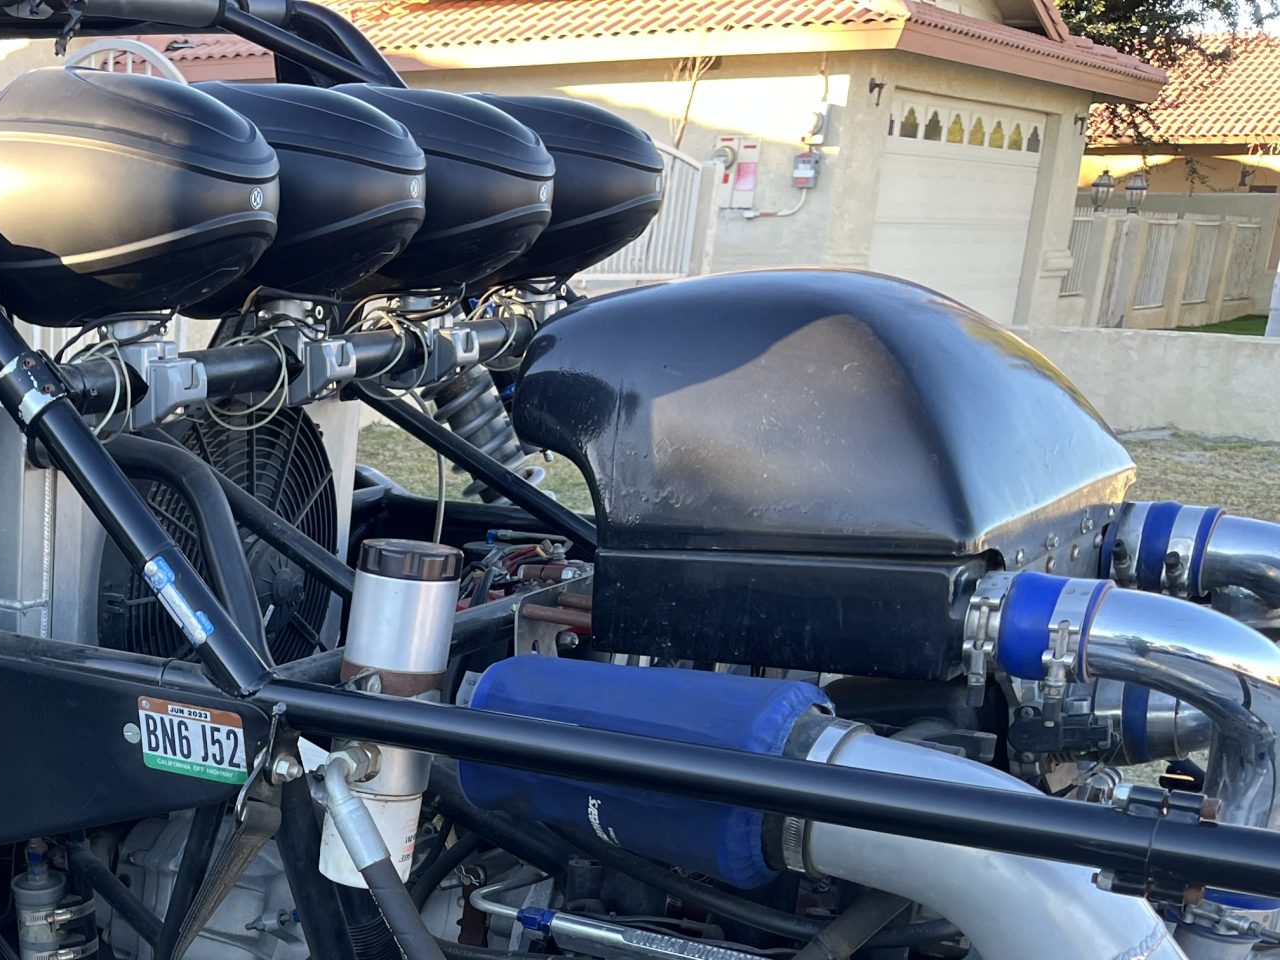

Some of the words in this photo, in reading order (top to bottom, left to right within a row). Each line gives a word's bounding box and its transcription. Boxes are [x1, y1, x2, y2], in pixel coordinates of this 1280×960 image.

[169, 706, 184, 716] JUN
[187, 709, 208, 719] 2023
[144, 713, 192, 760] BN6
[200, 724, 241, 769] J52
[156, 758, 192, 770] CALIFORNIA
[192, 765, 204, 773] OFF
